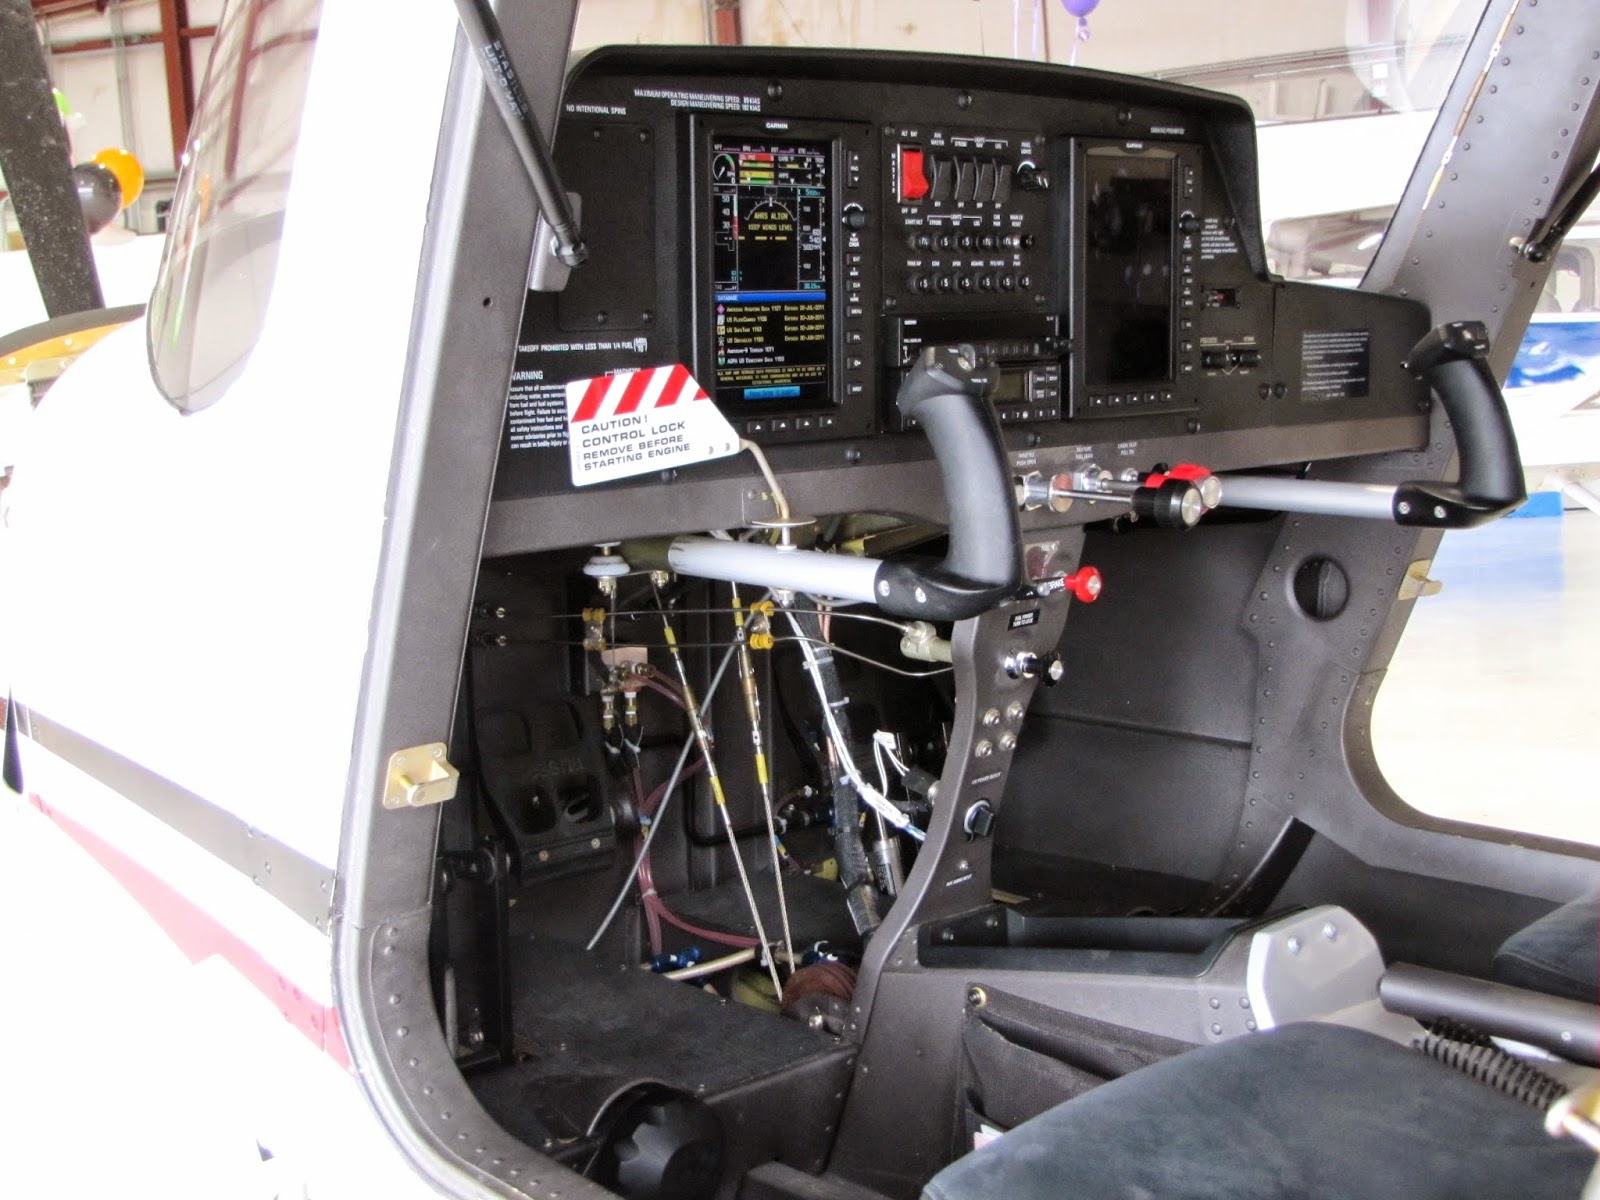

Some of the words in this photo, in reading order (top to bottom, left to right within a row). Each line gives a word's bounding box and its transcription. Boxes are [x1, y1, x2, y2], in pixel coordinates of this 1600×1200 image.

[634, 89, 660, 98] MAXIMUM
[661, 90, 688, 100] OPERATING
[689, 92, 724, 102] MANEUVERING
[566, 104, 574, 112] NO
[576, 105, 609, 114] INTENTIONAL
[611, 106, 626, 115] SPINS
[671, 99, 689, 107] DESIGN
[689, 100, 724, 110] MANEUVERING
[771, 212, 788, 220] ALIGN
[779, 224, 793, 232] LEVEL
[518, 344, 539, 352] TAKEOFF
[541, 344, 569, 352] PROHIBITED
[621, 341, 633, 349] FUEL
[582, 429, 646, 448] CONTROL
[651, 421, 686, 435] LOCK
[583, 444, 633, 460] REMOVE
[638, 435, 684, 450] BEFORE
[584, 453, 643, 471] STARTING
[648, 443, 691, 458] ENGINE
